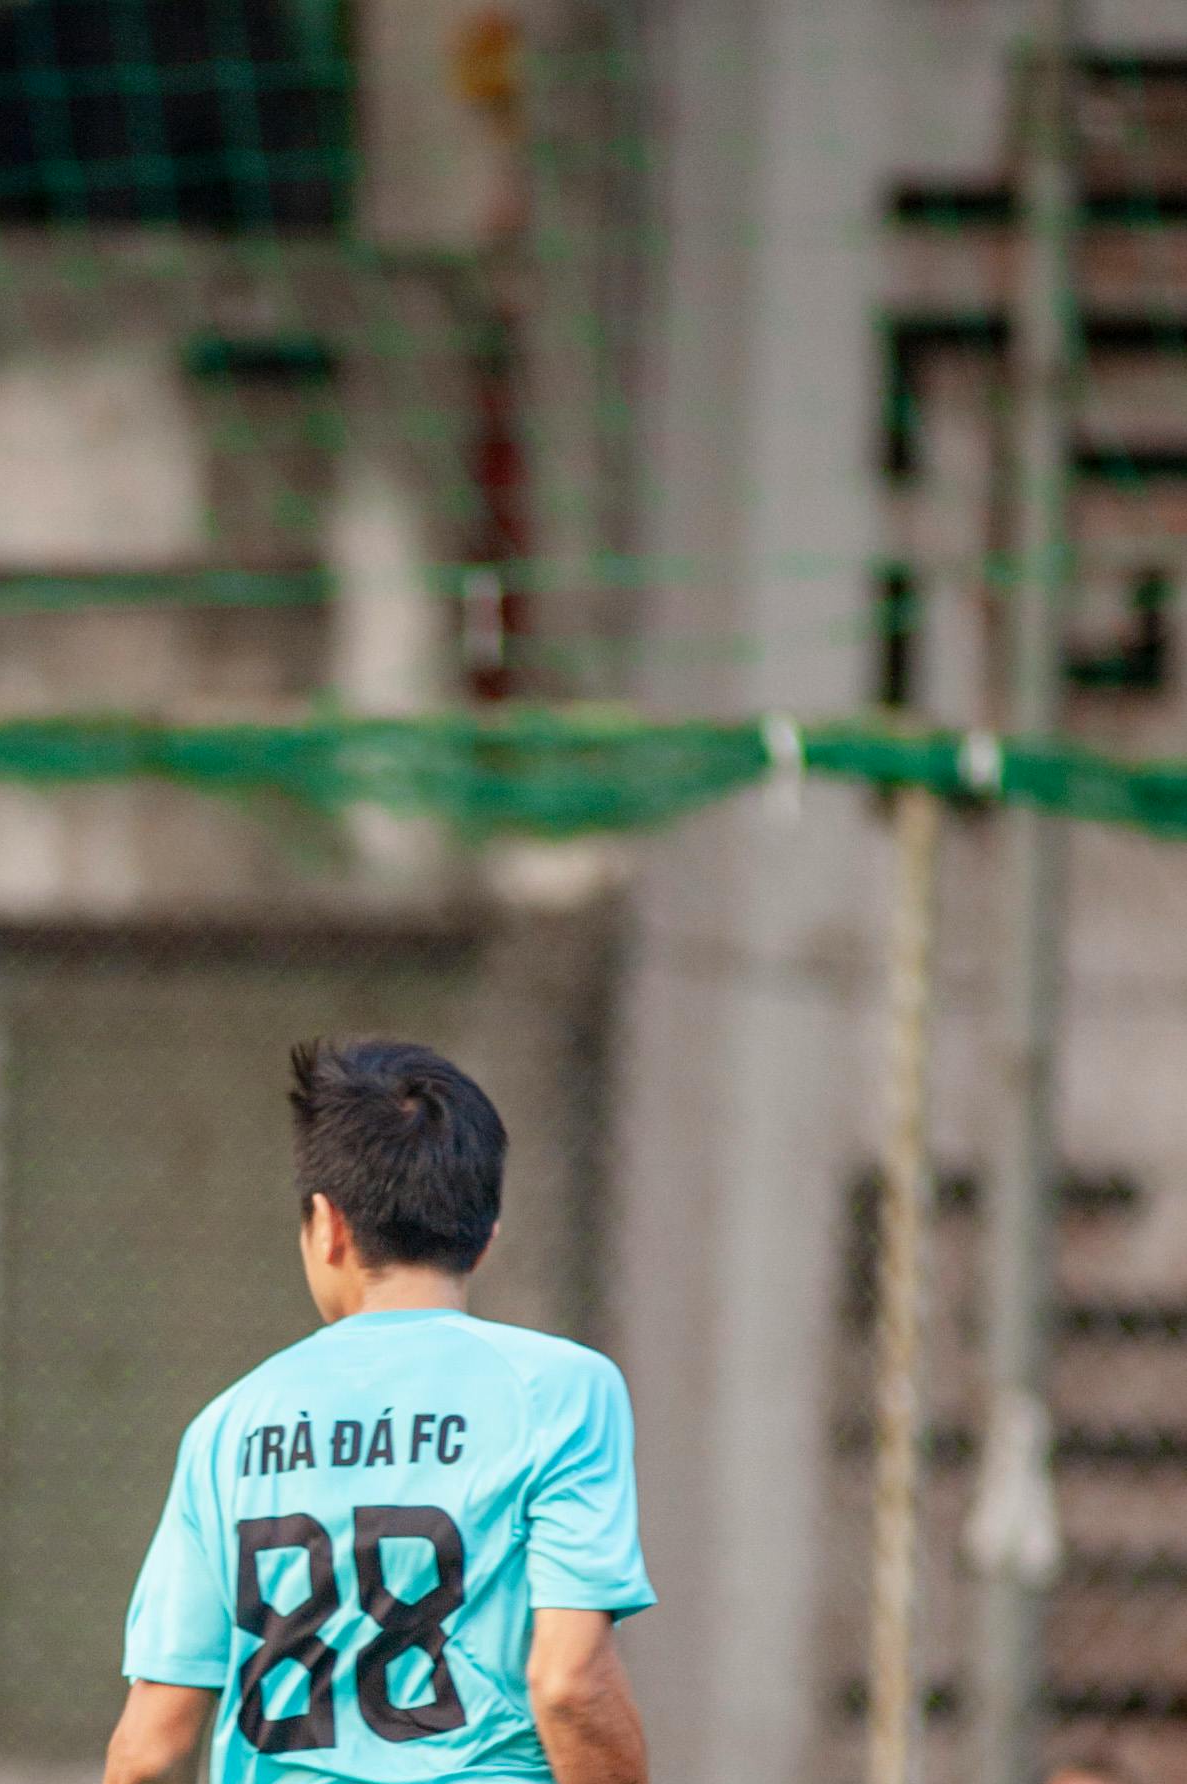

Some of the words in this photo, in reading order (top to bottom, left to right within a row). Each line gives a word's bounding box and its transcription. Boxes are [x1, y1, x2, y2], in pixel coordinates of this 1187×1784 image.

[242, 1411, 317, 1477] TRÀ
[330, 1407, 395, 1468] ĐÁ
[409, 1413, 468, 1465] FC
[236, 1505, 467, 1755] 88
